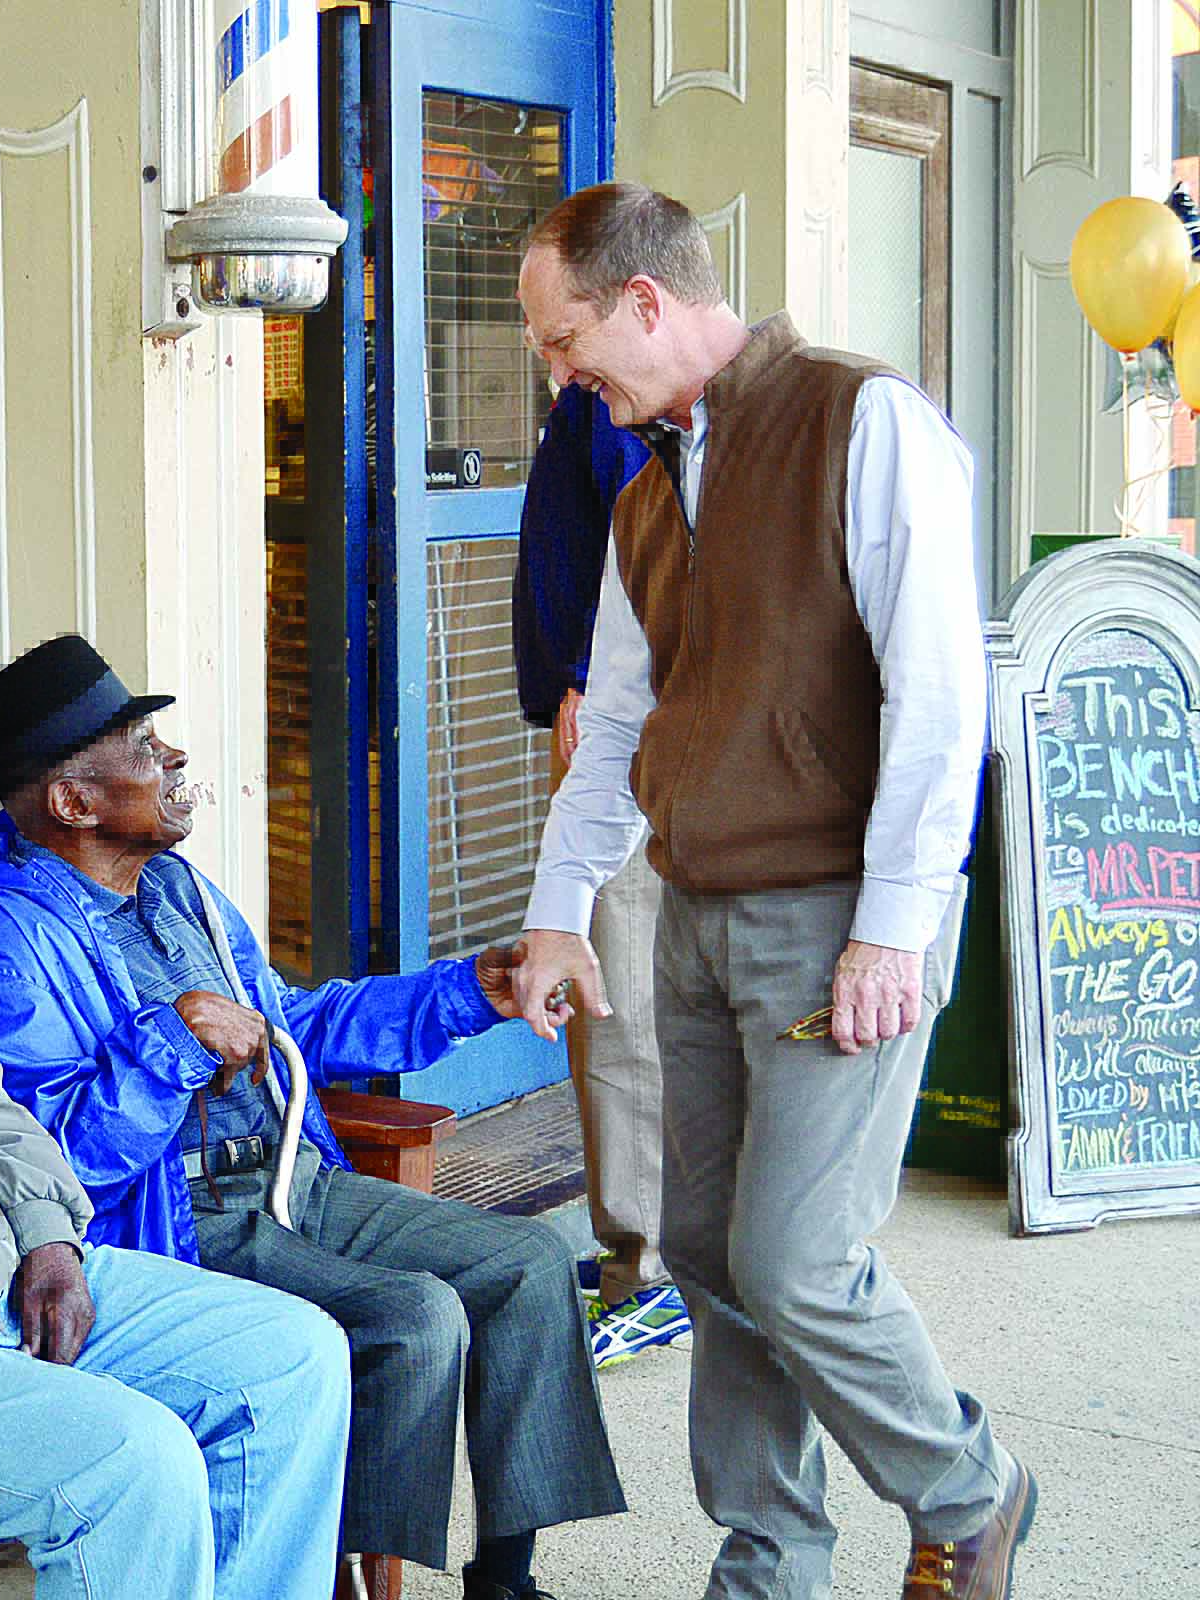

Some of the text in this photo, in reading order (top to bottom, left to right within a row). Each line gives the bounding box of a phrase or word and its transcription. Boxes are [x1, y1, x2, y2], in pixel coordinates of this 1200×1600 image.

[1062, 671, 1181, 738] This
[1038, 735, 1200, 808] BENCH
[1049, 904, 1169, 959] Always
[1050, 948, 1198, 1003] THE GO
[1056, 1039, 1133, 1087] Will
[1057, 1080, 1128, 1114] LOVED
[1129, 1077, 1149, 1110] by
